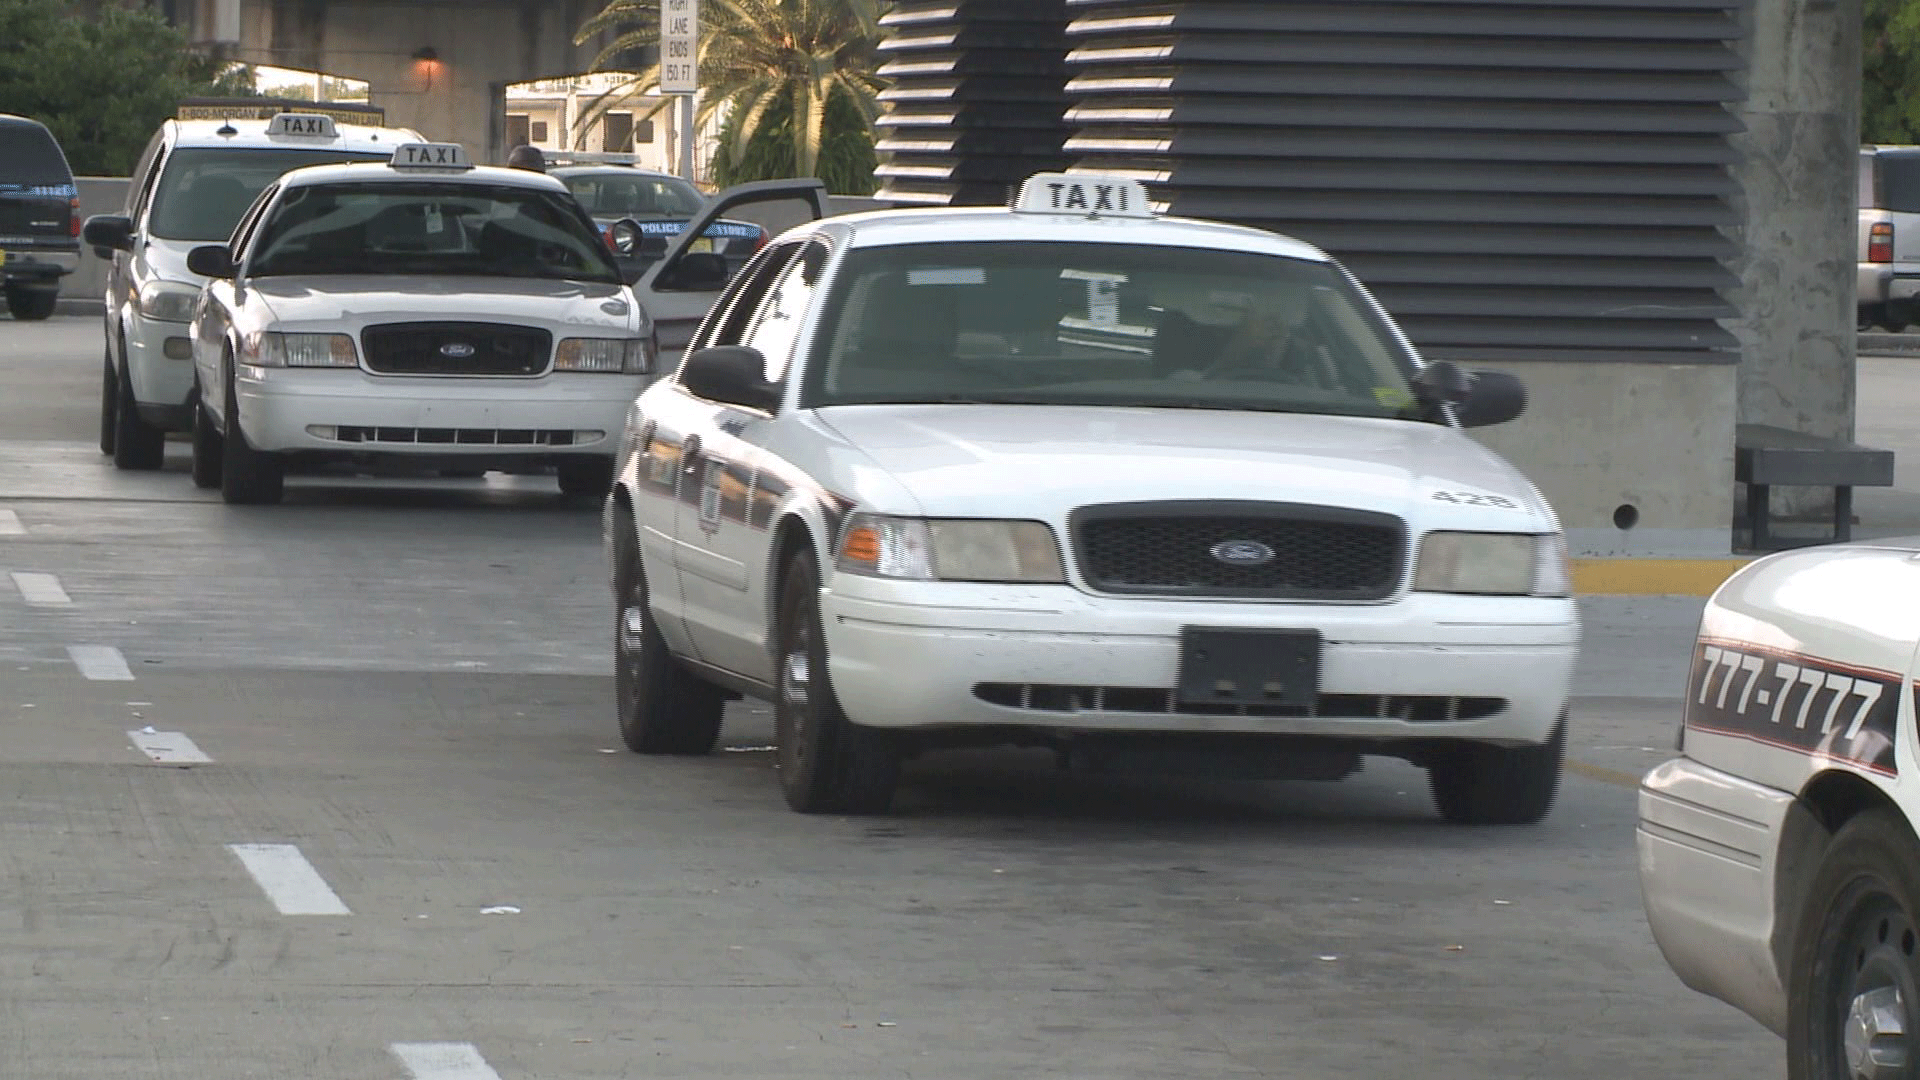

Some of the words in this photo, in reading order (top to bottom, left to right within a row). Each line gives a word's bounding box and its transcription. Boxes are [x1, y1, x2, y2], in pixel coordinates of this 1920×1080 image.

[669, 16, 688, 34] LANE
[669, 41, 688, 57] ENDS
[682, 64, 690, 80] FT
[283, 117, 323, 133] TAXI
[406, 147, 457, 163] TAXI
[1047, 183, 1129, 212] TAXI
[640, 223, 680, 234] POLICE
[1431, 490, 1519, 509] 428
[1698, 646, 1883, 740] 777-7777
